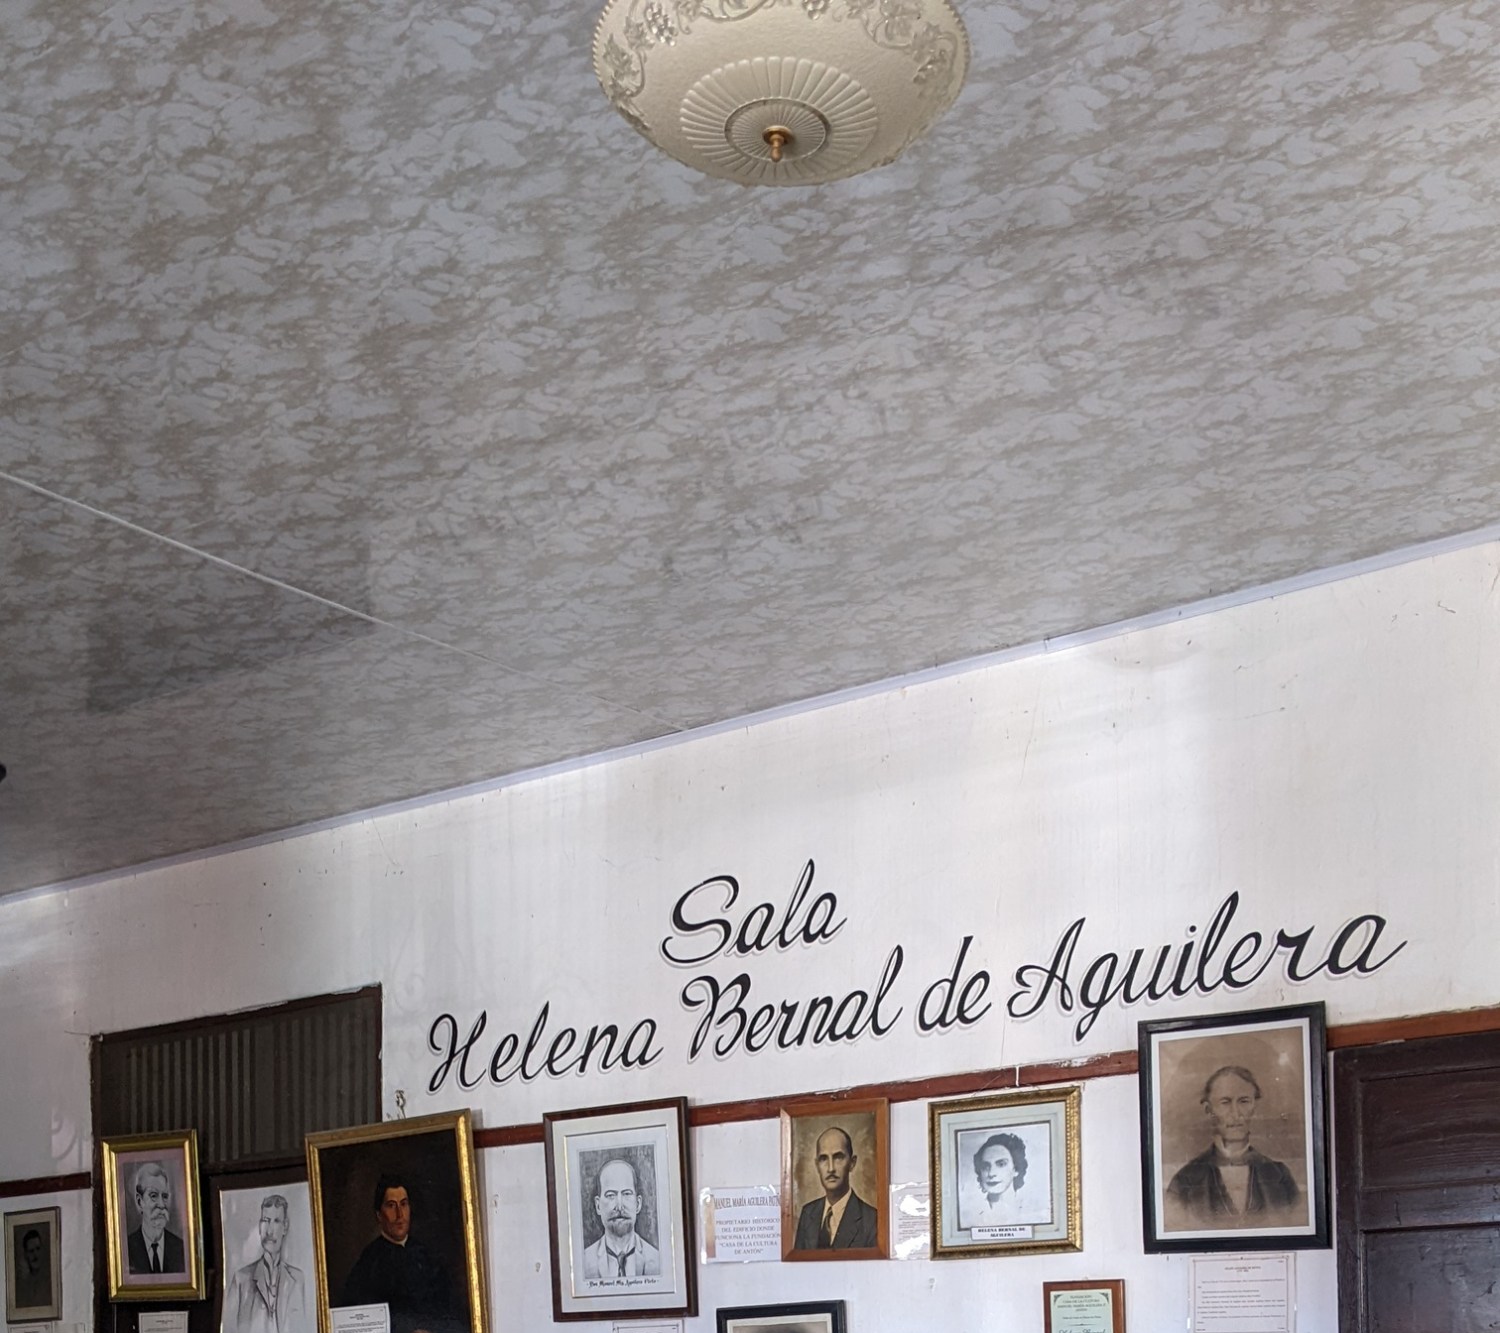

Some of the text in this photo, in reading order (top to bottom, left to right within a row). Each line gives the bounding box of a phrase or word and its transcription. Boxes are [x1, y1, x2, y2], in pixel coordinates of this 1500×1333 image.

[660, 858, 847, 965] Sala
[428, 890, 1405, 1092] Helena Bernal de Aguilera
